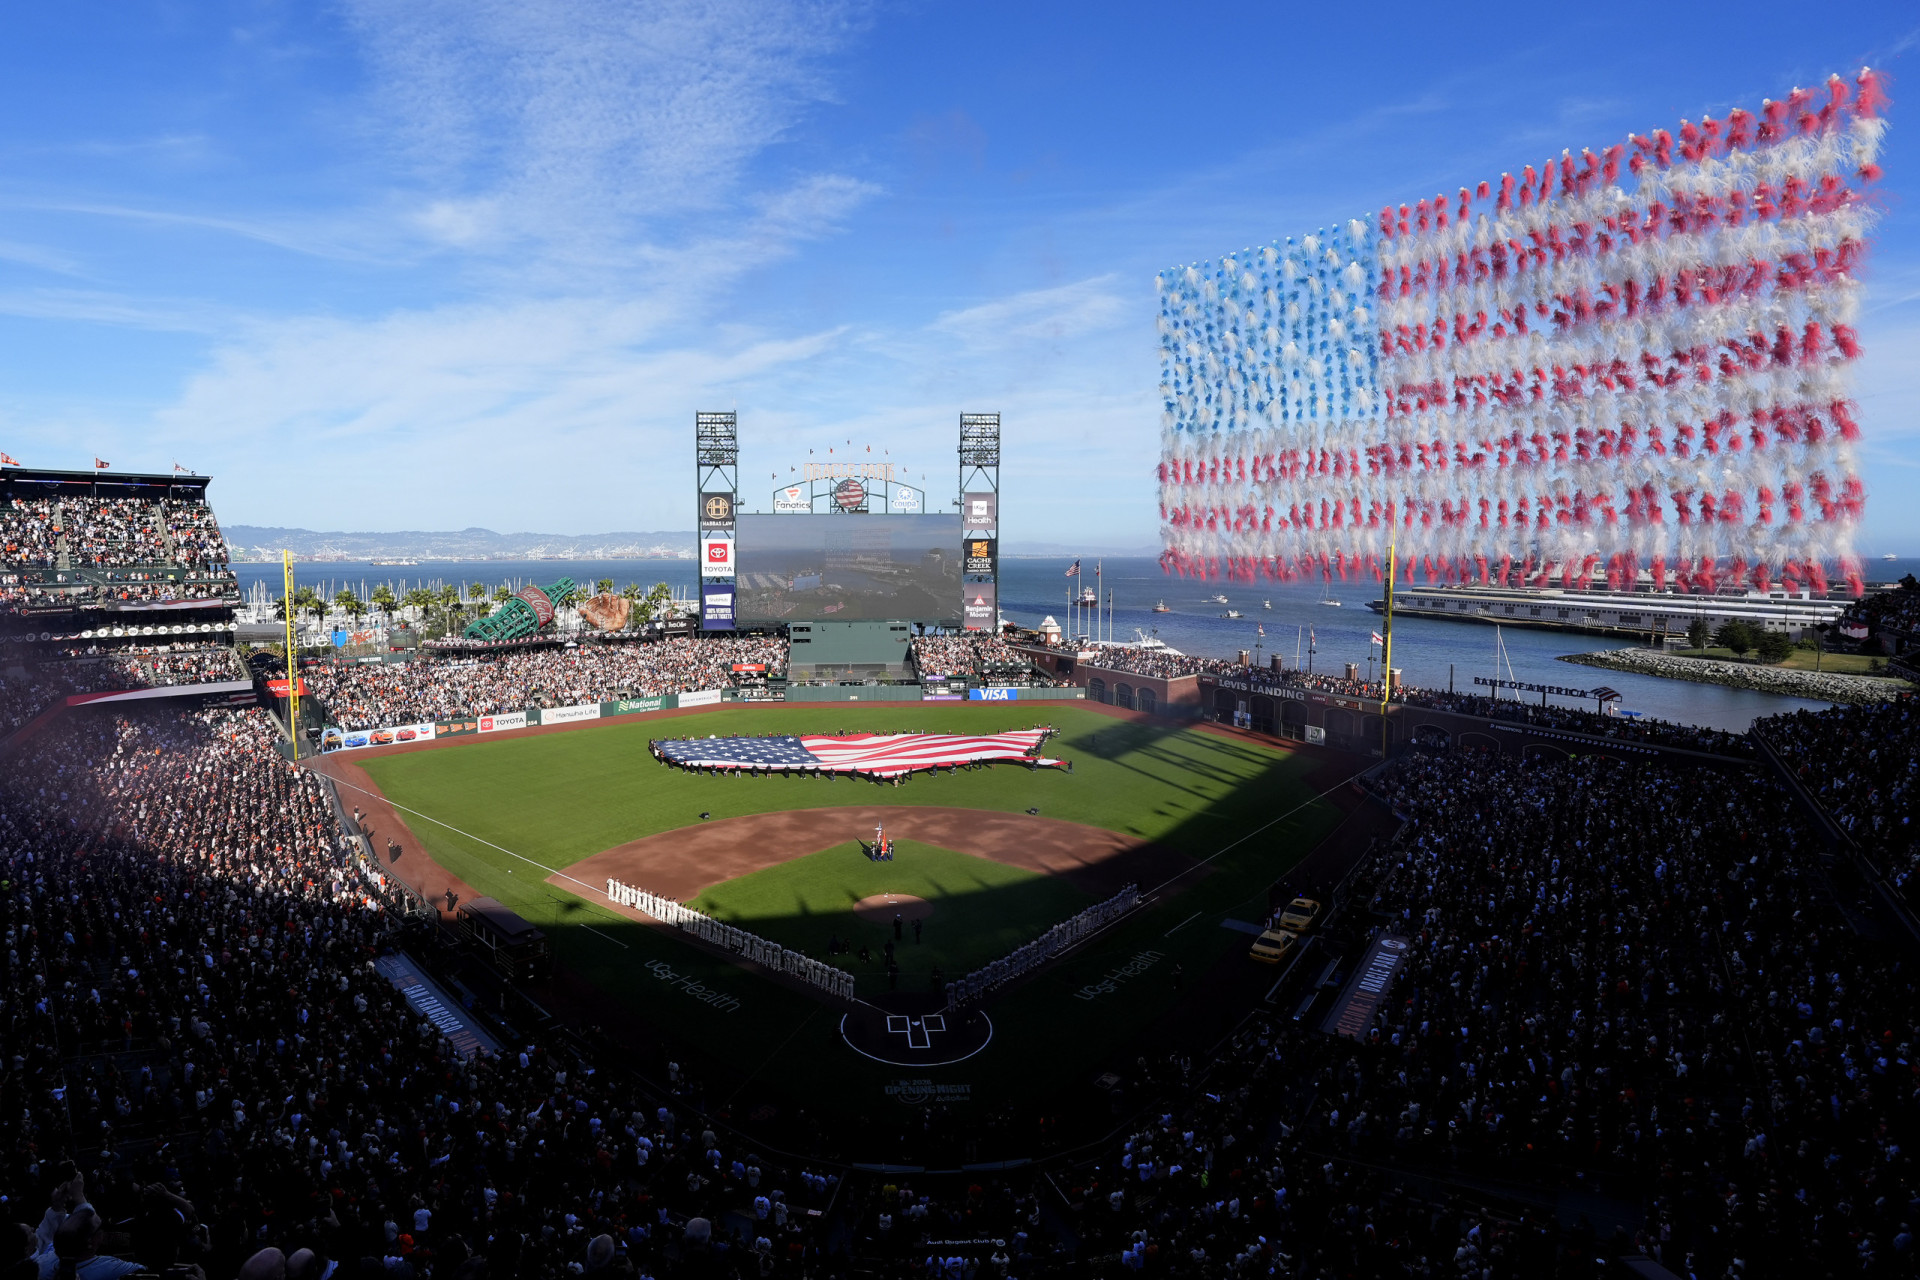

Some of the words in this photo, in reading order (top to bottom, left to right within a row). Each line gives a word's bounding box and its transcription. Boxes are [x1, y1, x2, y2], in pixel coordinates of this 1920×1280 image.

[804, 463, 855, 482] ORACLE
[860, 463, 895, 482] PARK
[776, 500, 810, 509] Fanatics
[979, 690, 1009, 700] VISA
[1250, 683, 1304, 700] LANDING
[1474, 677, 1506, 688] BANK
[1509, 682, 1525, 690] OF
[1527, 684, 1587, 698] AMERICA
[629, 698, 662, 709] National
[1372, 952, 1398, 969] PARK
[1072, 979, 1118, 1000] UCSF
[1104, 950, 1168, 983] Health
[1358, 967, 1390, 992] ORACLE
[403, 984, 430, 999] SAN
[644, 960, 680, 983] UCSF
[670, 975, 741, 1013] Health
[415, 996, 464, 1033] FRANCISCO
[884, 1085, 936, 1095] OPENING
[937, 1084, 971, 1094] NIGHT
